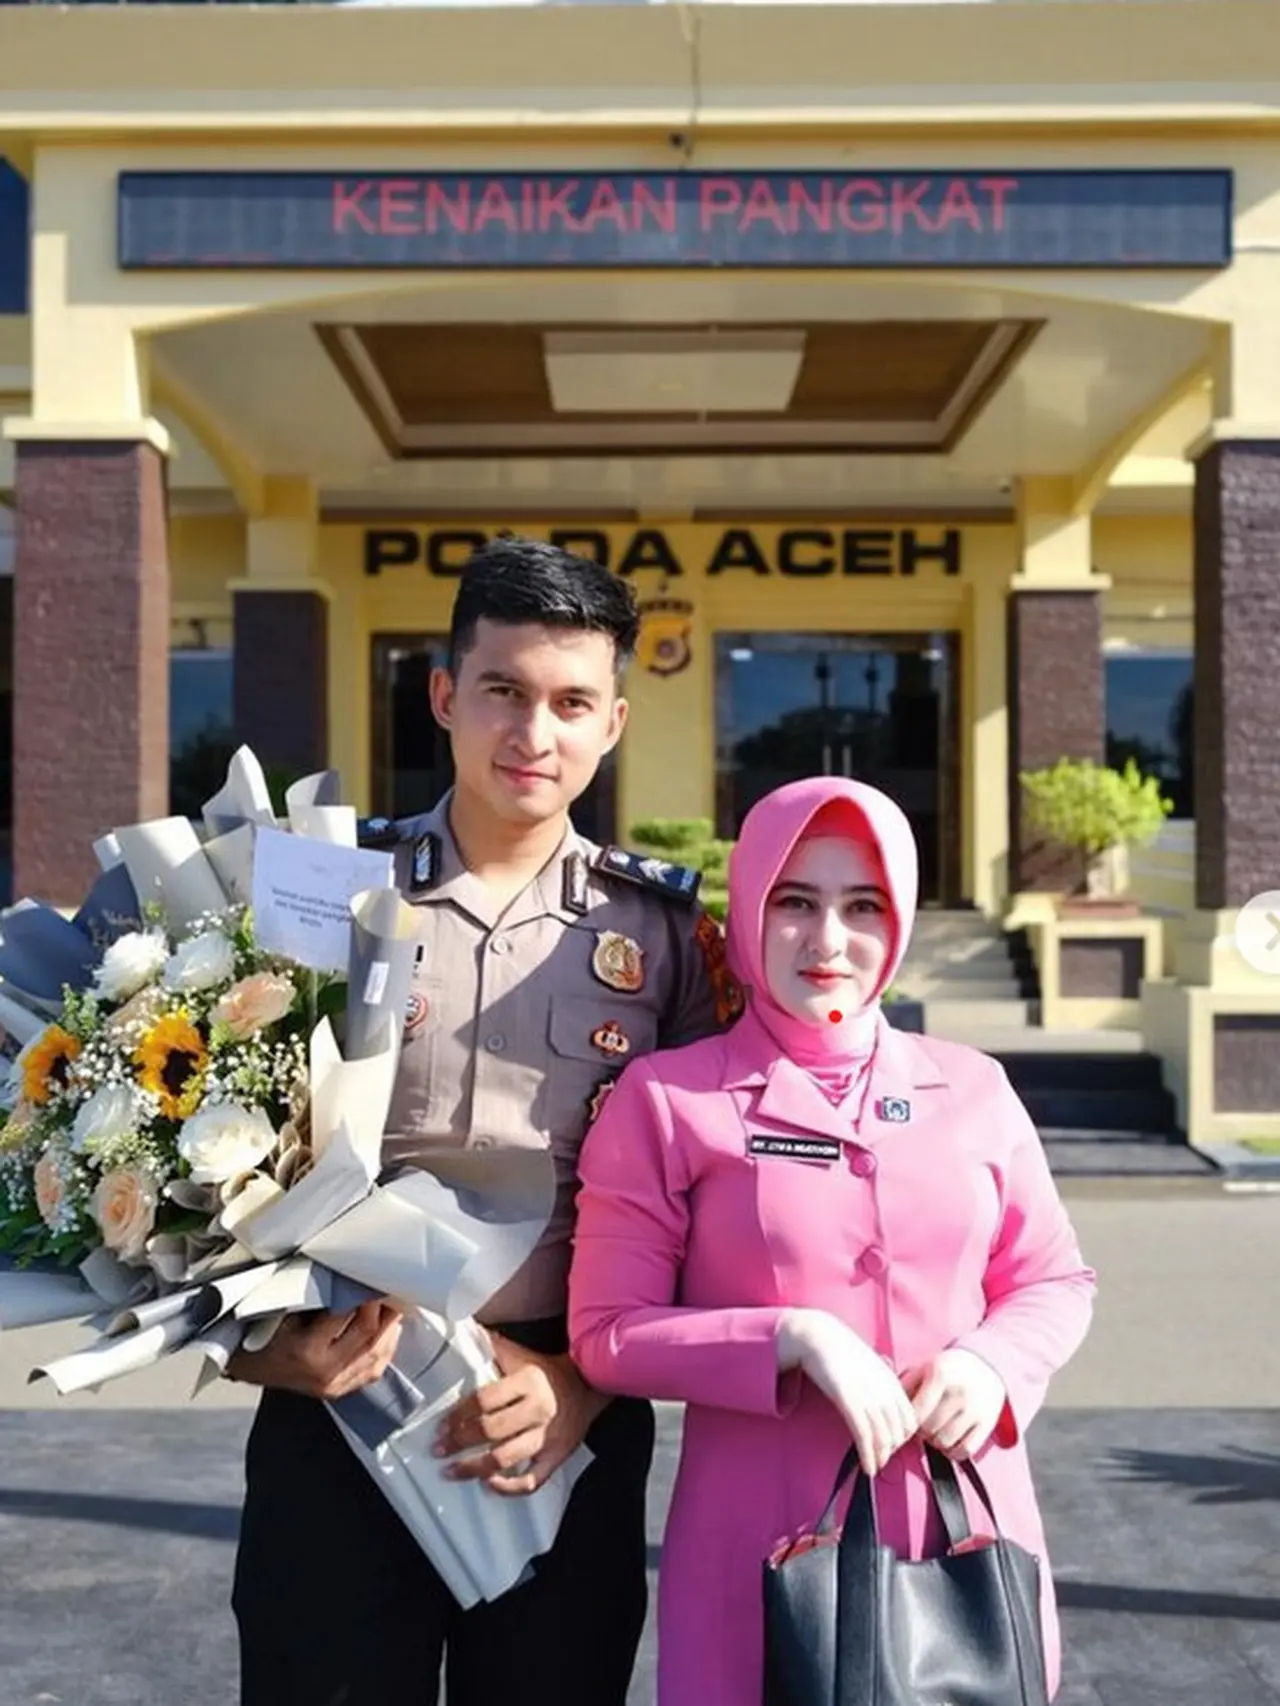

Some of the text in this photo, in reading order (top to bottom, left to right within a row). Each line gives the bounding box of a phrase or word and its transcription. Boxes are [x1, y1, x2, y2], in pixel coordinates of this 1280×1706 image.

[332, 178, 1018, 235] KENAIKAN PANGKAT
[365, 529, 961, 576] PODA ACEH
